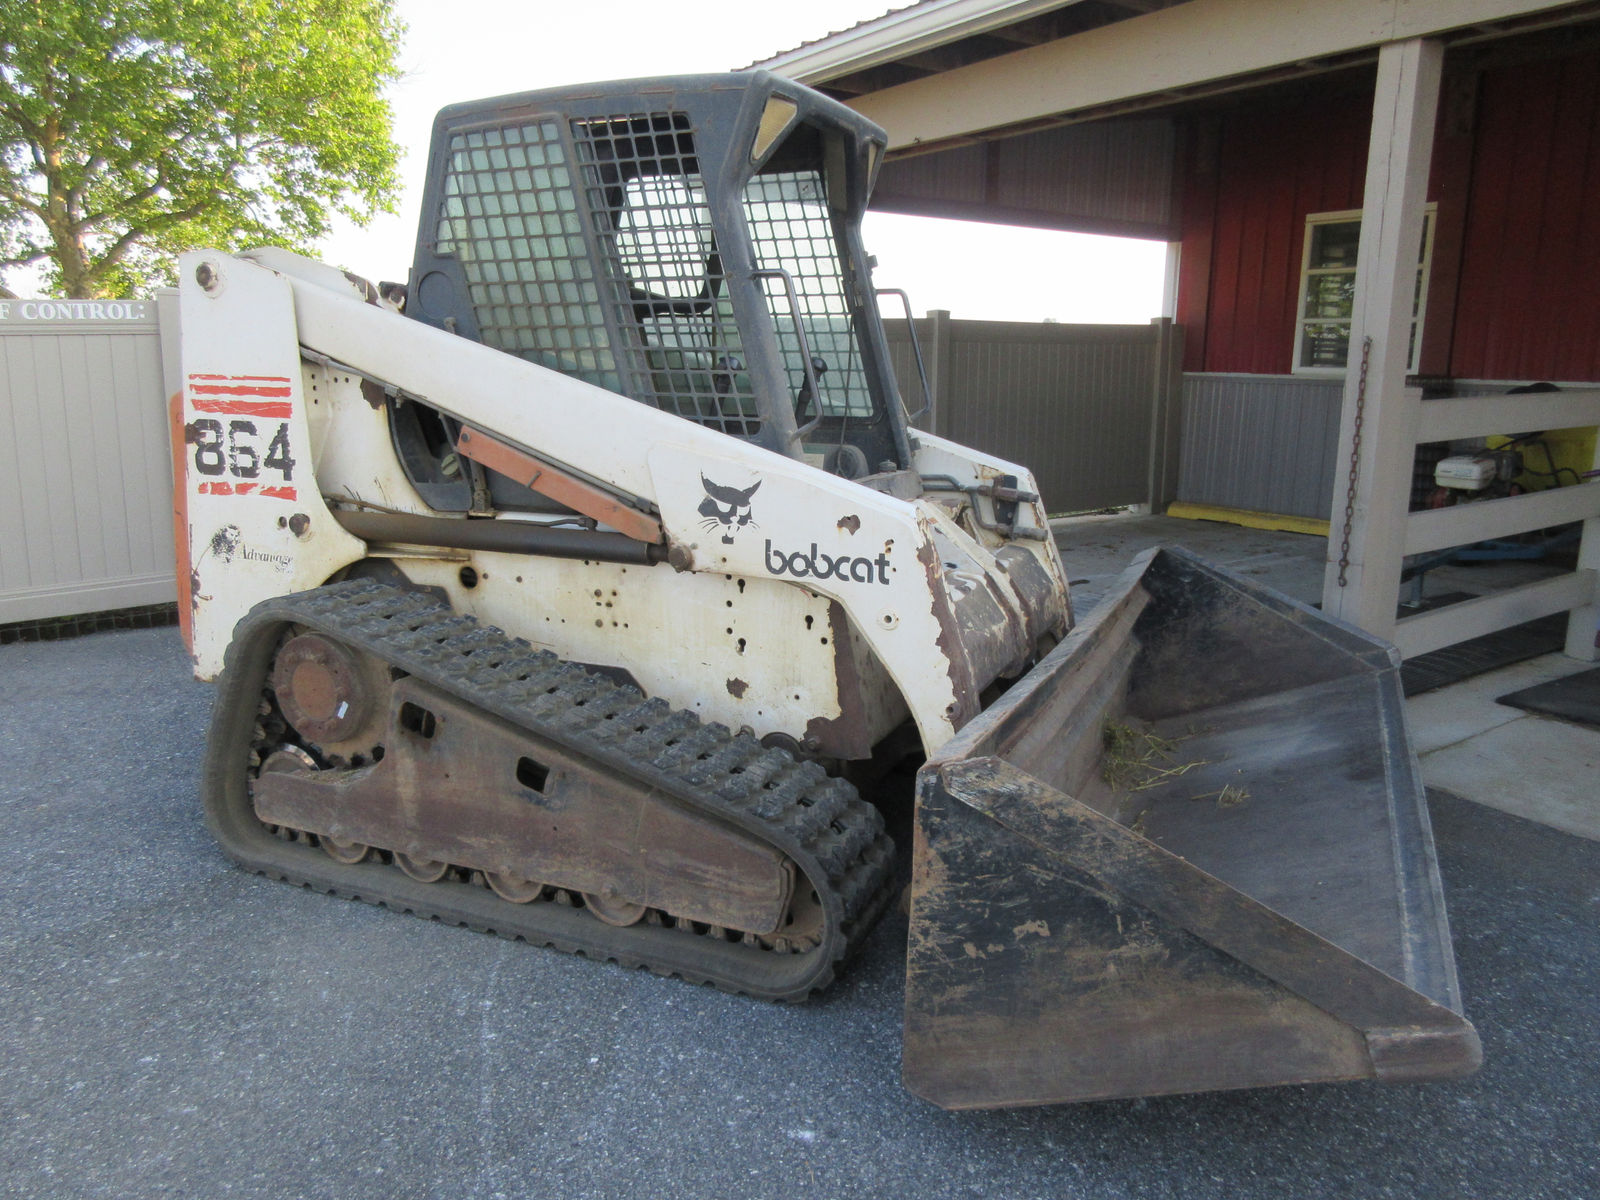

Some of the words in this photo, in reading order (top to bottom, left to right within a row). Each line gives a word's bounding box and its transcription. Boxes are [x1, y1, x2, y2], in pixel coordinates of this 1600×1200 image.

[22, 303, 146, 320] CONTROL:
[194, 418, 296, 481] 864
[765, 538, 890, 585] bobcat
